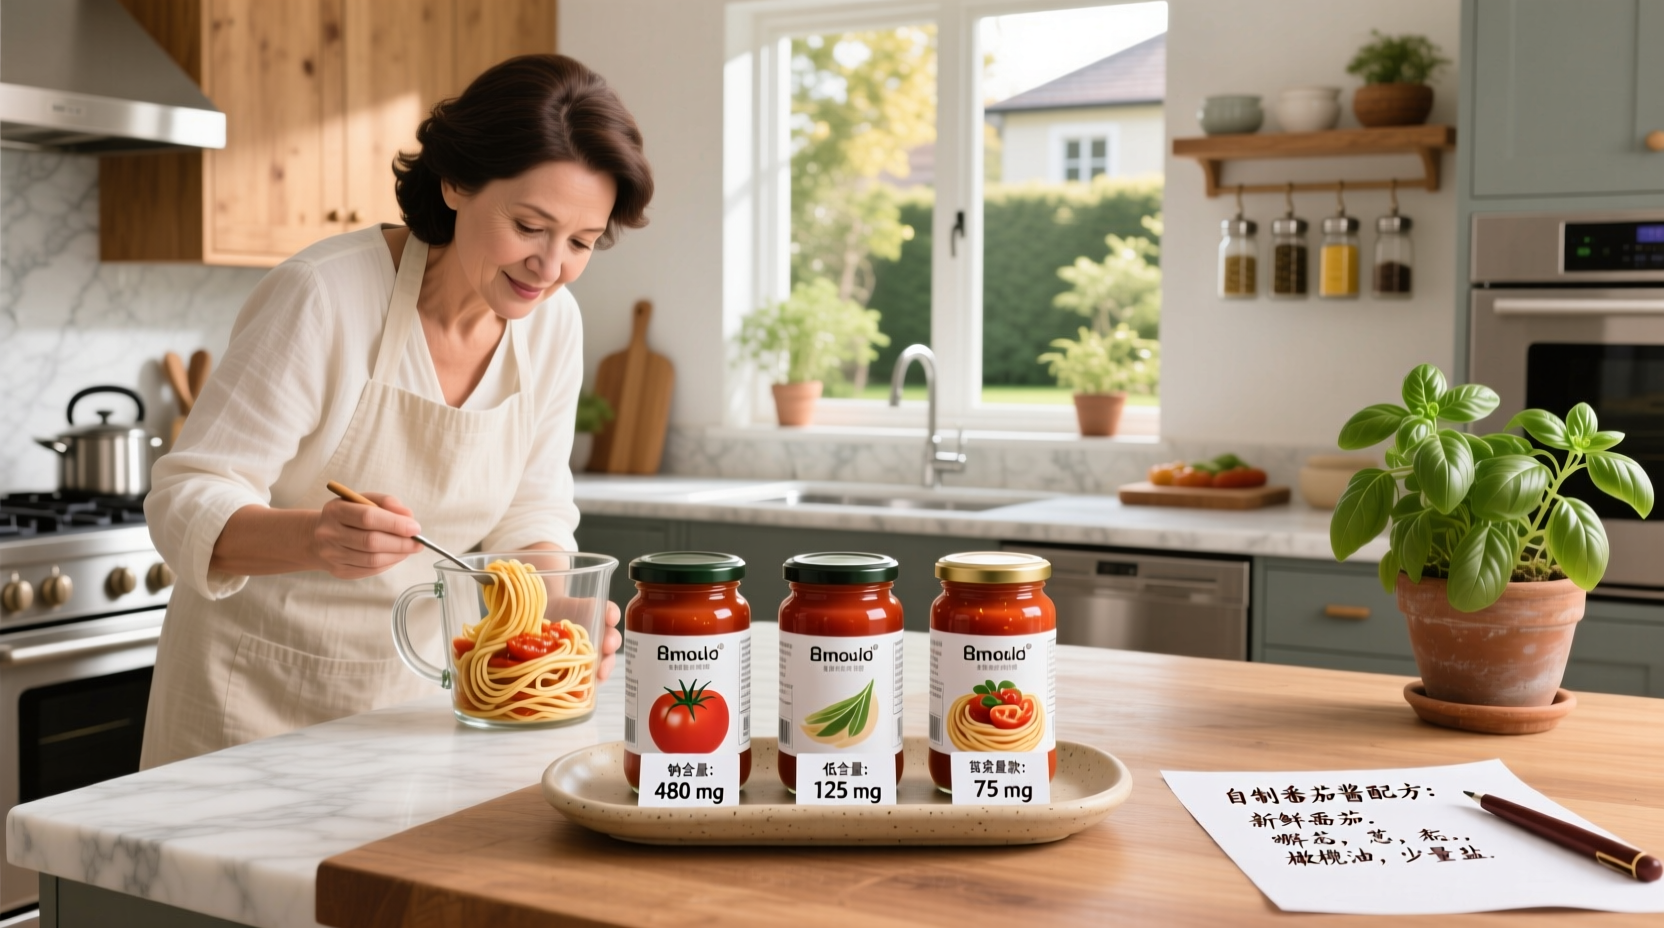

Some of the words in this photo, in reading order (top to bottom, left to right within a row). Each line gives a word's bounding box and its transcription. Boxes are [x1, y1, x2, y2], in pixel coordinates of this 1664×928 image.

[654, 781, 691, 800] 480
[696, 787, 724, 804] mg
[814, 780, 848, 799] 125
[853, 786, 882, 804] mg
[974, 779, 999, 798] 75
[1004, 785, 1033, 803] mg
